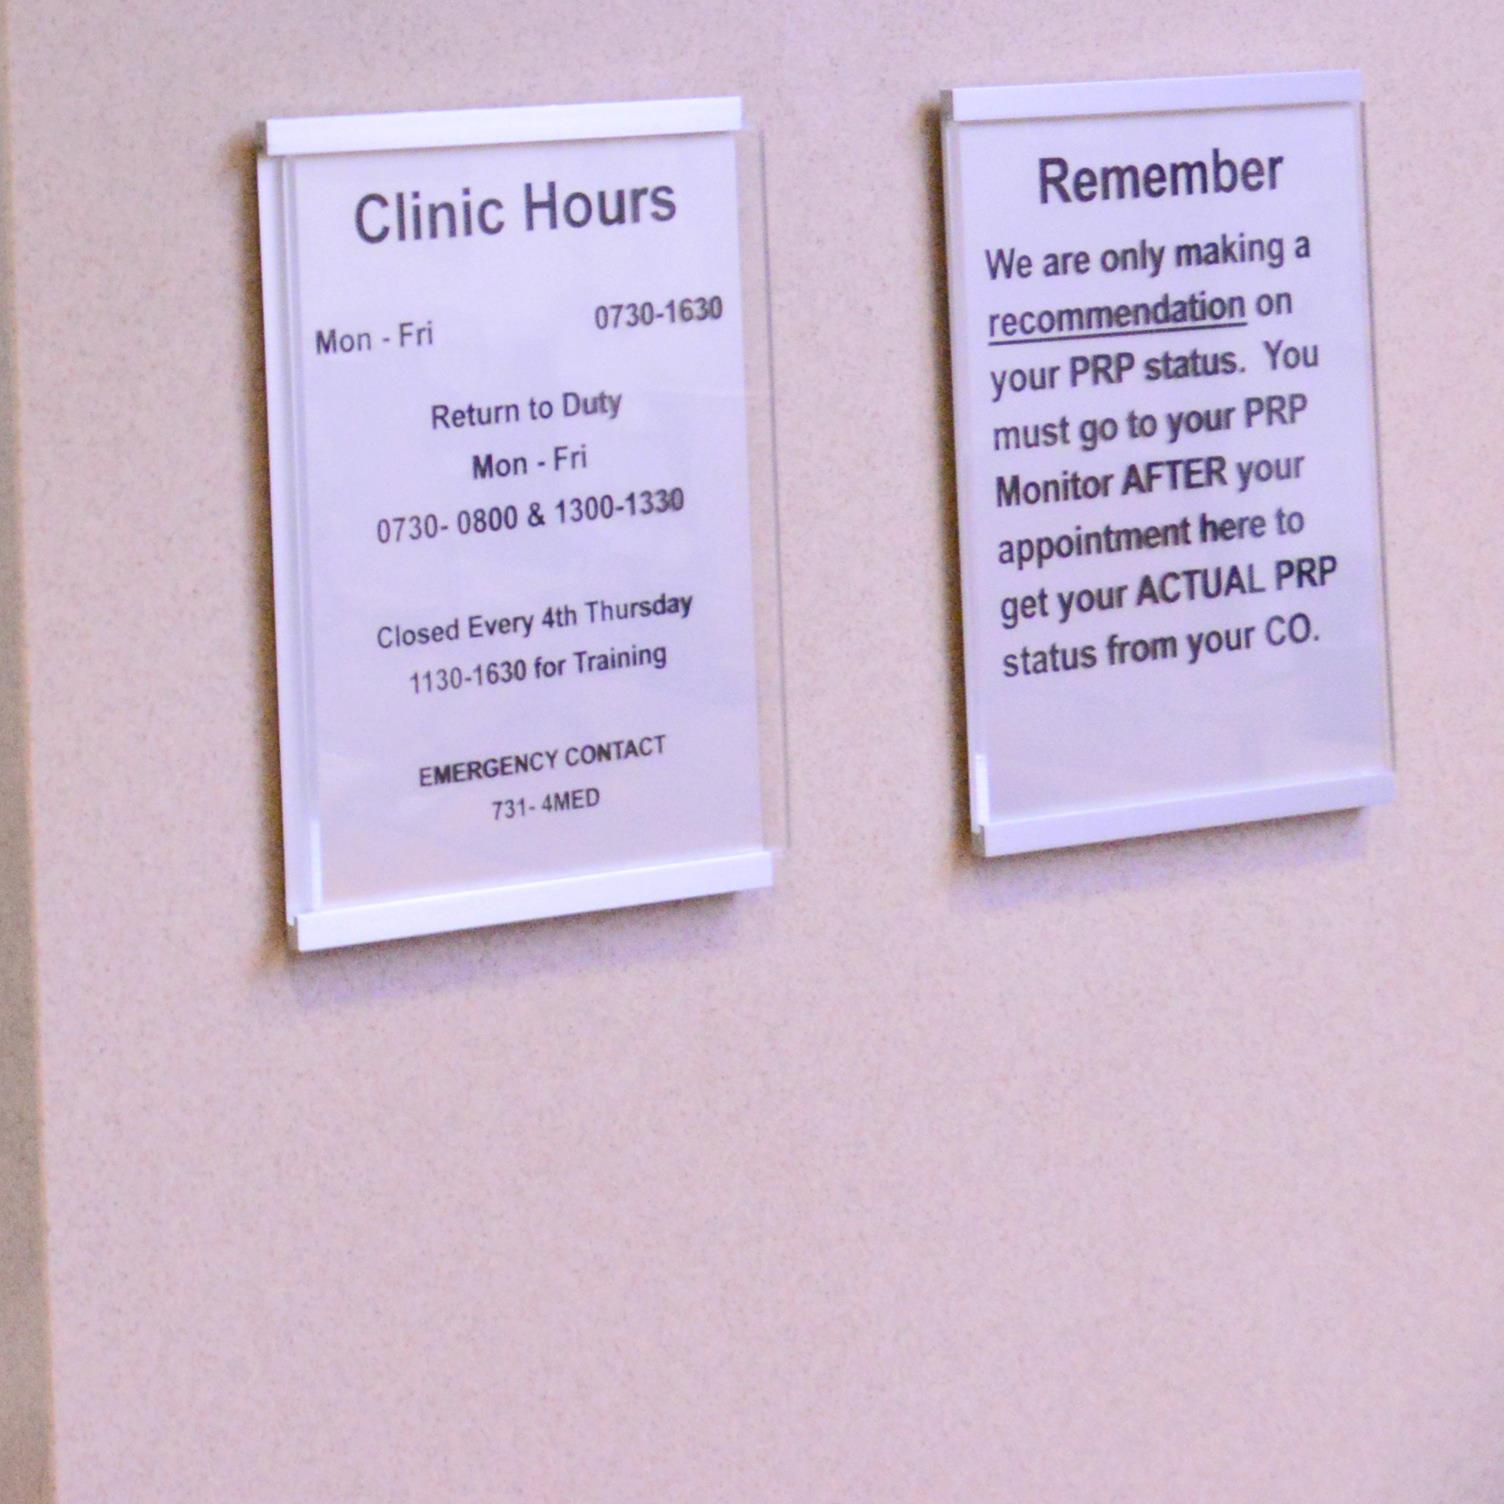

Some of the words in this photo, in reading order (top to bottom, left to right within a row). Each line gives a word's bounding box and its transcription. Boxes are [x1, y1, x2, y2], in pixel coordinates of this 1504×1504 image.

[1039, 148, 1284, 204] Remember
[354, 187, 504, 244] Clinic
[524, 181, 676, 232] Hours
[985, 248, 1032, 280] We
[1043, 249, 1090, 277] are
[1101, 240, 1164, 278] only
[1175, 233, 1284, 268] making
[1295, 236, 1310, 258] a
[315, 328, 372, 354] Mon
[400, 321, 433, 347] Fri
[595, 296, 723, 330] 0730-1630
[988, 291, 1247, 337] recommendation
[1256, 292, 1292, 316] on
[991, 364, 1060, 402] your
[1070, 353, 1134, 387] PRP
[1145, 349, 1245, 381] status.
[1263, 340, 1319, 371] You
[431, 399, 519, 429] Return
[529, 398, 553, 419] to
[563, 391, 622, 419] Duty
[994, 416, 1070, 450] must
[1080, 417, 1118, 451] go
[1127, 410, 1157, 438] to
[1166, 406, 1236, 443] your
[1244, 394, 1307, 428] PRP
[472, 454, 527, 479] Mon
[554, 445, 587, 471] Fri
[996, 471, 1114, 507] Monitor
[1121, 456, 1227, 495] AFTER
[1236, 455, 1305, 492] your
[377, 514, 449, 543] 0730-
[457, 506, 518, 535] 0800
[528, 502, 545, 527] &
[555, 488, 684, 524] 1300-1330
[998, 517, 1190, 570] appointment
[1200, 513, 1266, 543] here
[1275, 508, 1305, 534] to
[1001, 593, 1049, 629] get
[1057, 583, 1128, 623] your
[1136, 564, 1265, 606] ACTUAL
[1275, 555, 1337, 590] PRP
[377, 619, 459, 649] Closed
[469, 611, 533, 638] Every
[541, 606, 577, 629] 4th
[585, 593, 692, 624] Thursday
[1003, 643, 1097, 677] status
[1107, 634, 1178, 665] from
[1186, 625, 1255, 663] your
[1265, 613, 1319, 646] CO.
[410, 665, 526, 694] 1130-1630
[534, 653, 566, 679] for
[573, 645, 667, 675] Training
[419, 750, 558, 787] EMERGENCY
[565, 735, 667, 767] CONTACT
[492, 798, 535, 821] 731-
[541, 788, 600, 813] 4MED
